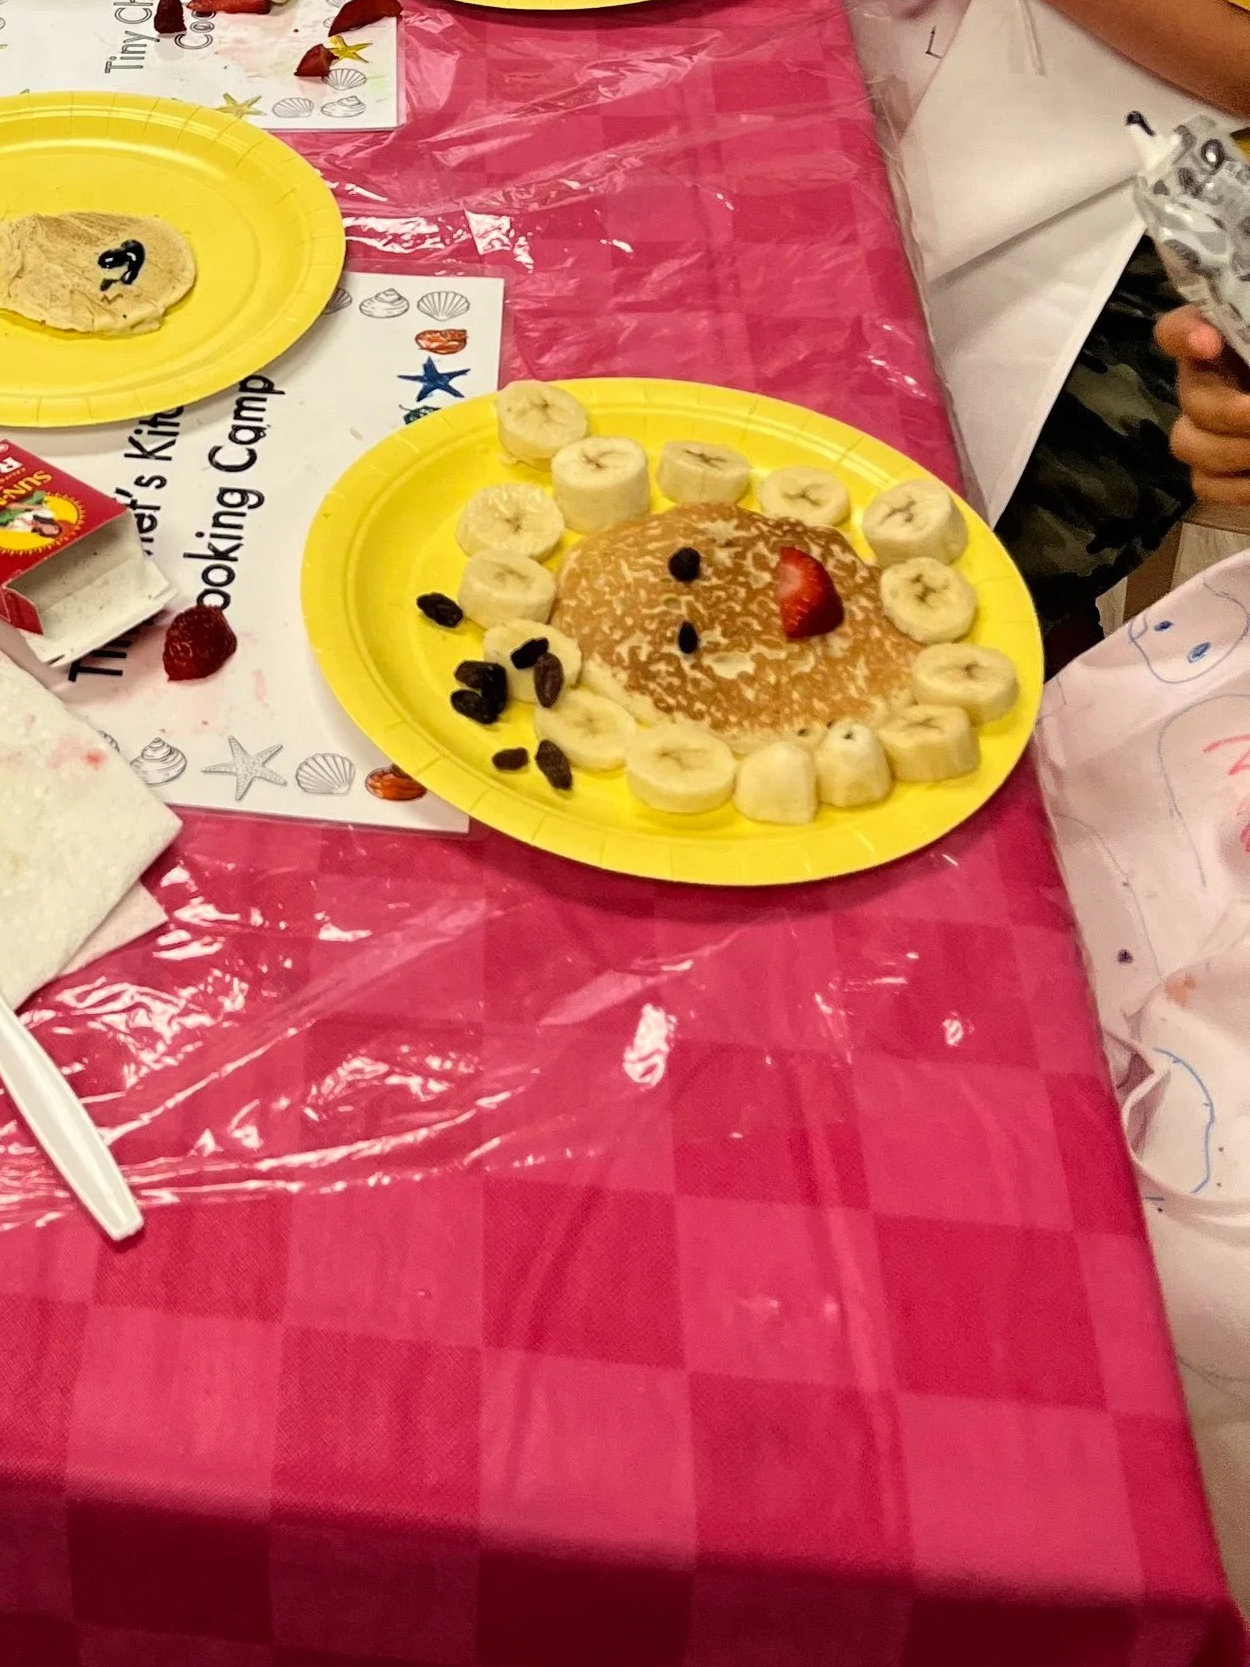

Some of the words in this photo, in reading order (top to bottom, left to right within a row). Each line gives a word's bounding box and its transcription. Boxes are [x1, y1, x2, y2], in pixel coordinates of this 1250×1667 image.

[104, 30, 161, 74] Tiny
[207, 374, 286, 473] Camp
[182, 486, 265, 613] ooking
